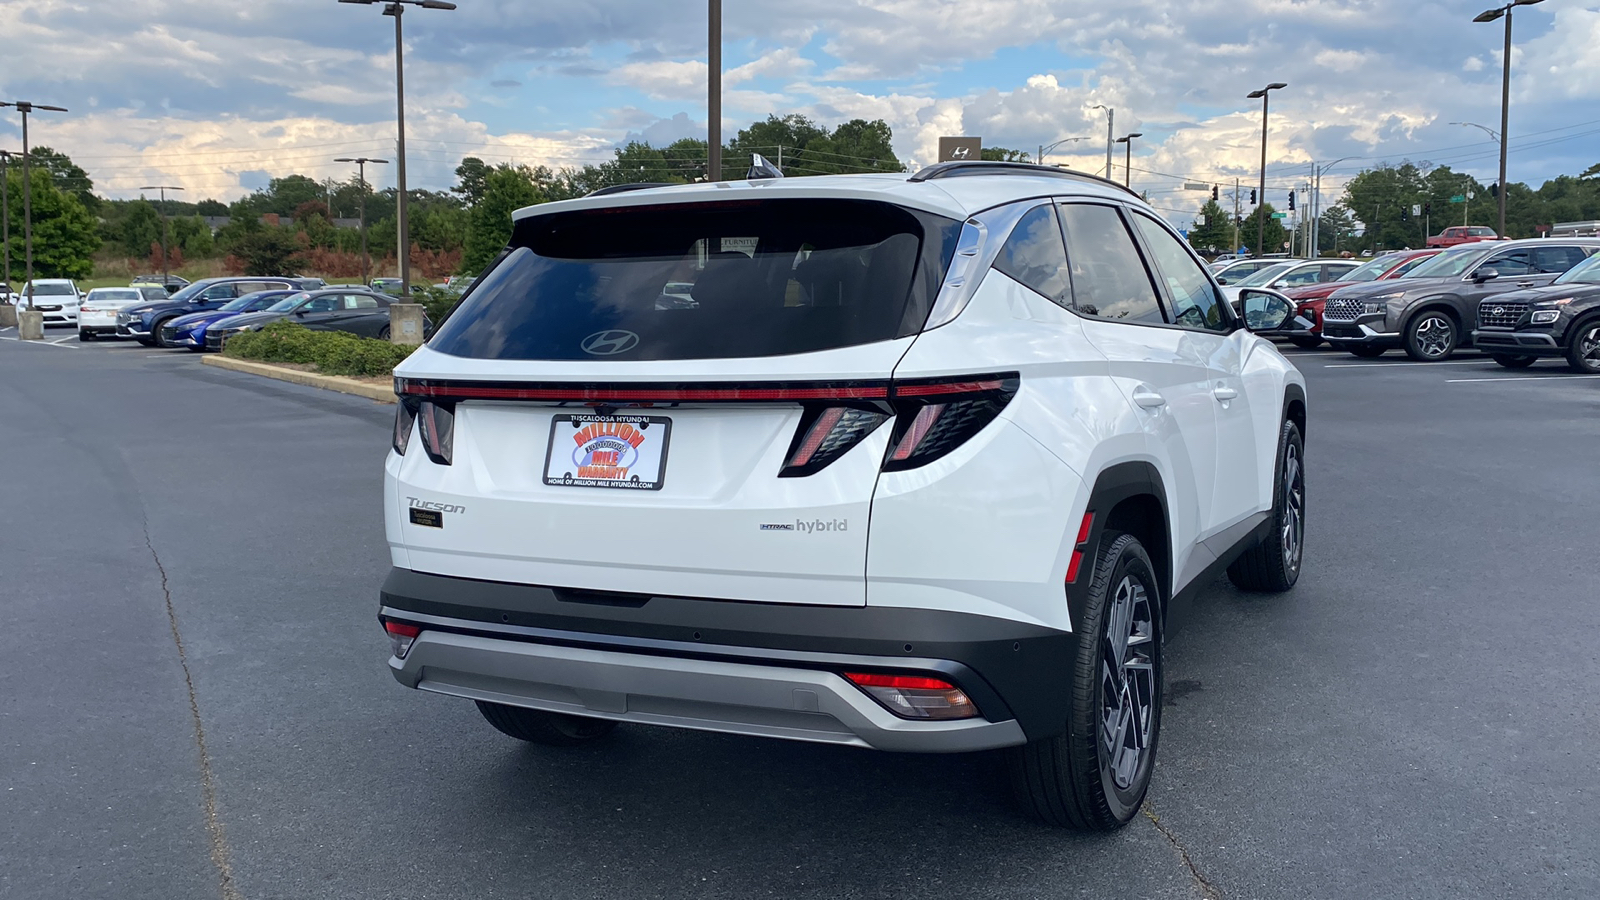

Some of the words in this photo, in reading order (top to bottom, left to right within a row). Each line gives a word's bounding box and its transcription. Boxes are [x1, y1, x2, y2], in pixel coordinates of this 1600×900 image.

[573, 422, 645, 449] MILLION
[591, 451, 619, 466] MILE
[578, 466, 629, 479] WARRANTY
[796, 518, 848, 534] hybrid
